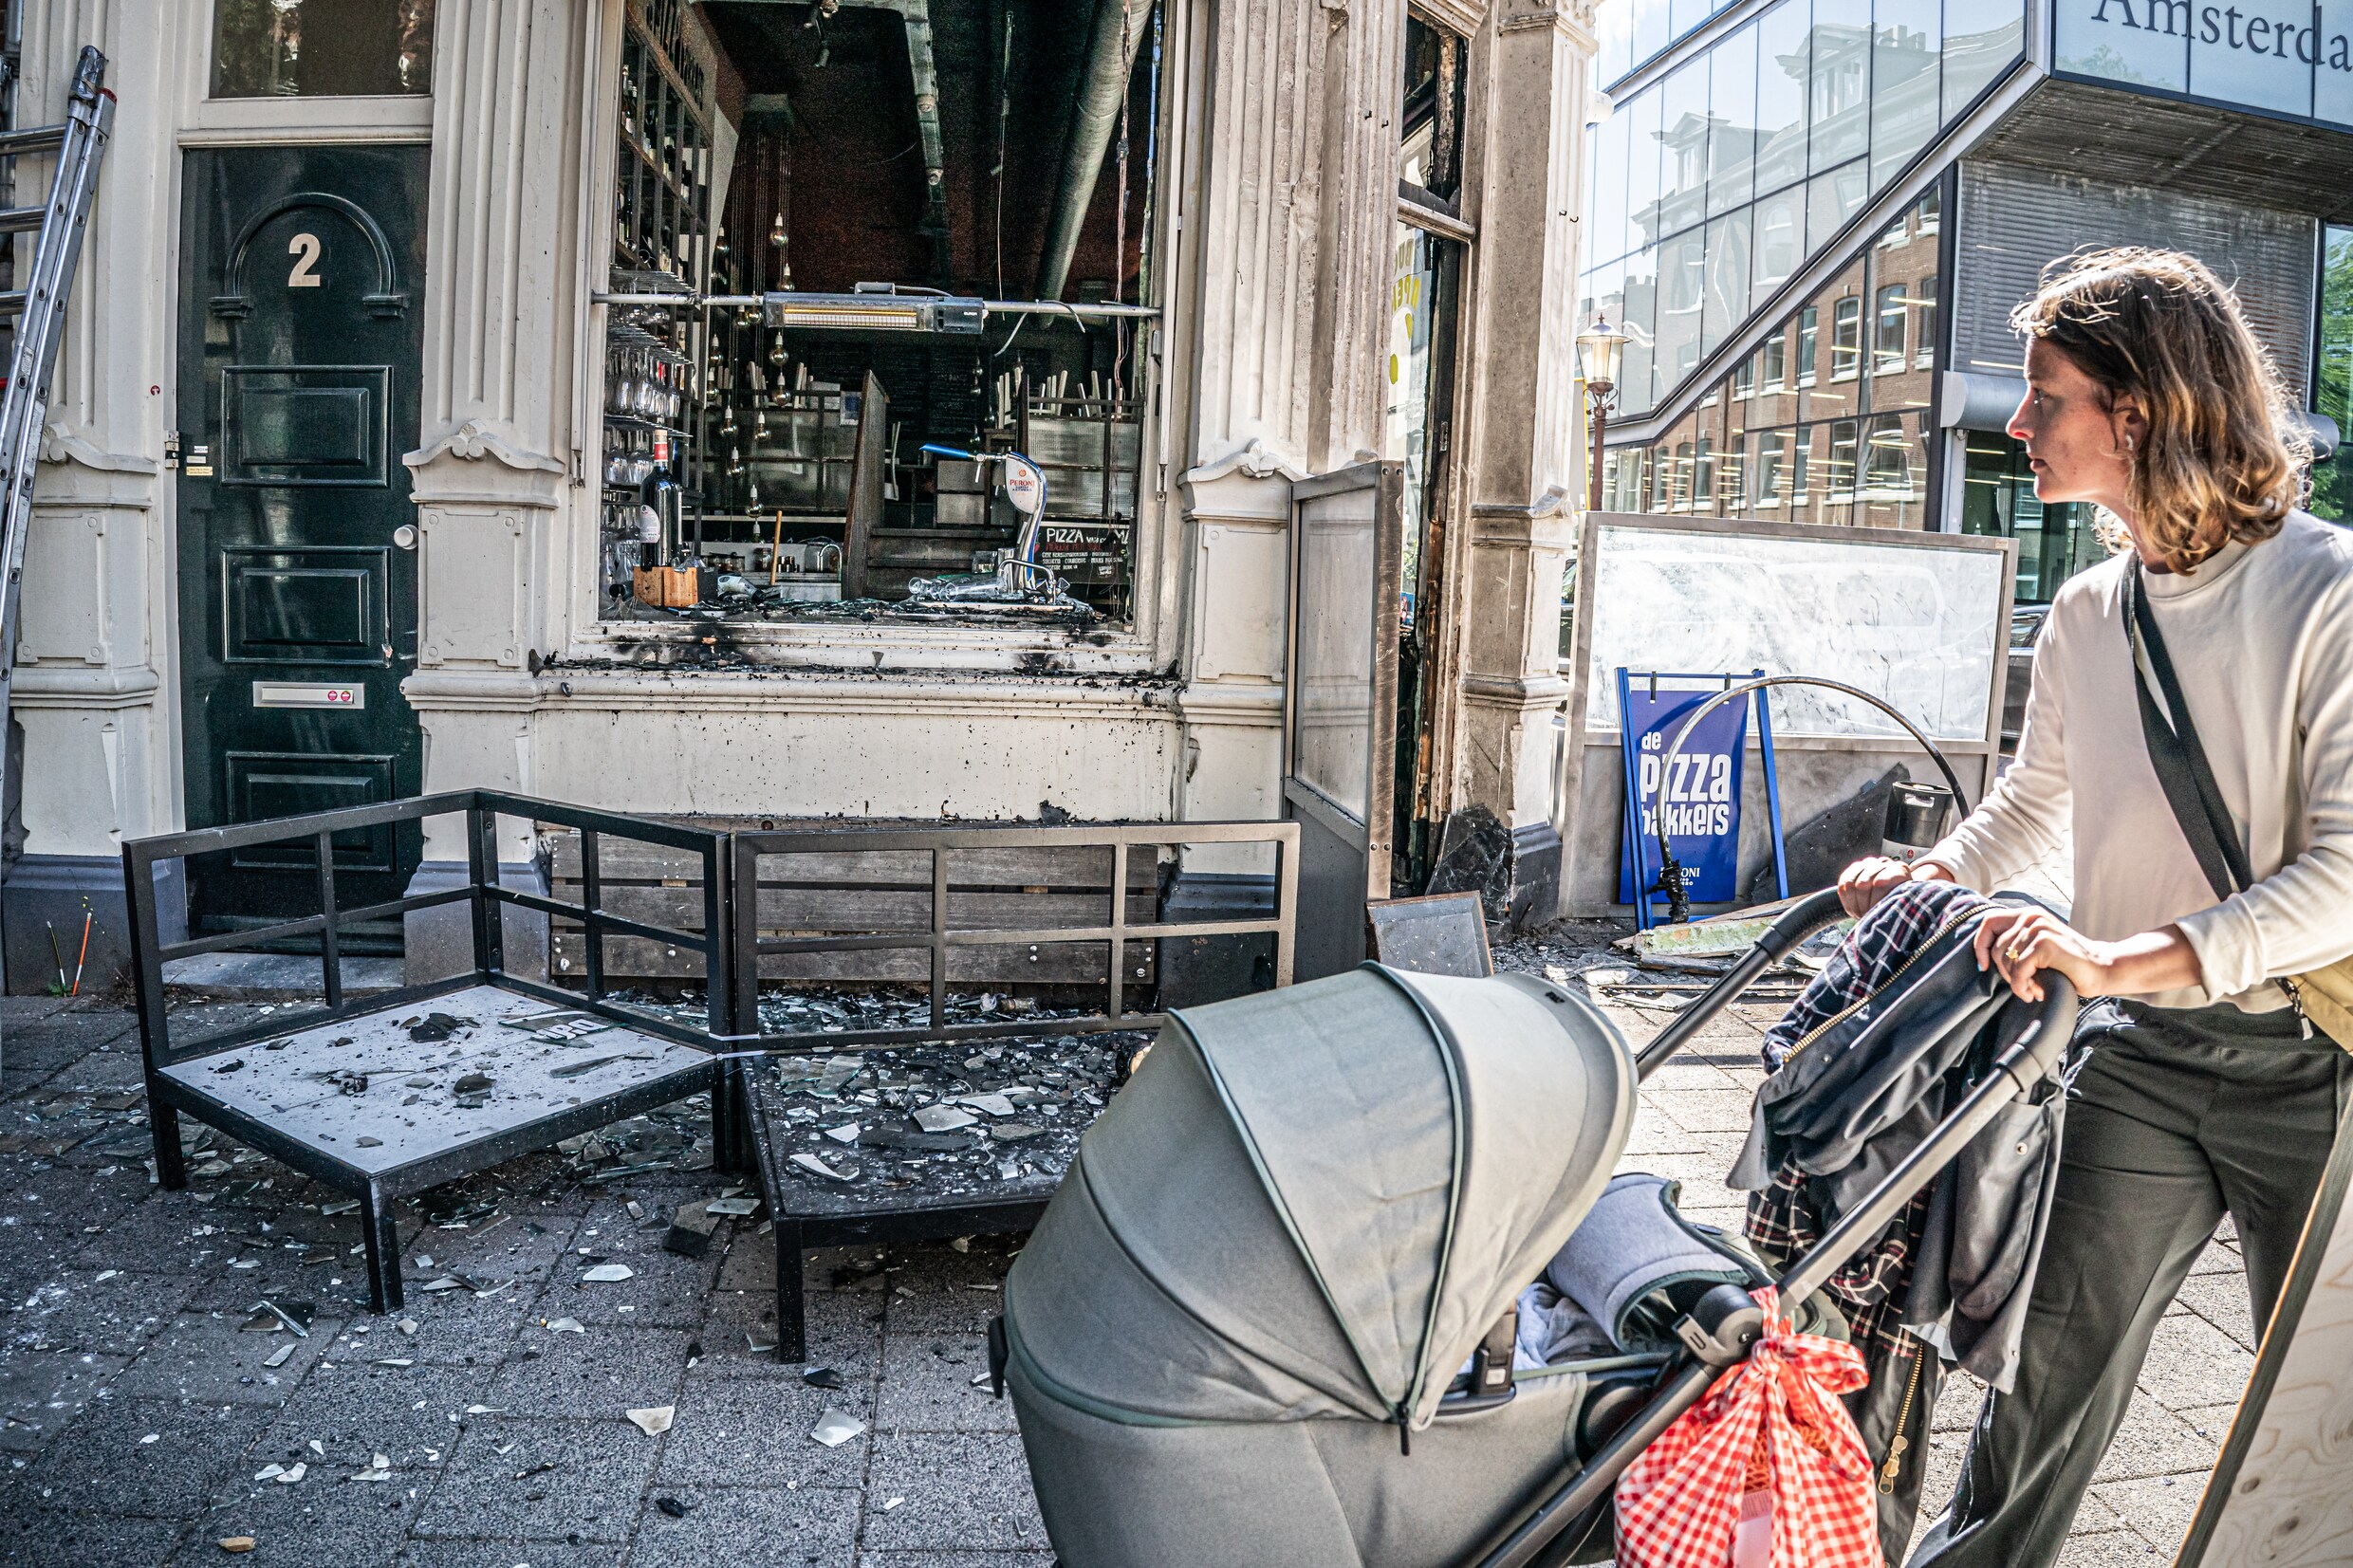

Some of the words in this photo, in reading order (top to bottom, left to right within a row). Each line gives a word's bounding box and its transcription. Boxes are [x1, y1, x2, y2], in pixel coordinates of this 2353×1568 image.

[288, 232, 321, 287] 2
[1047, 528, 1084, 543] PIZZA
[1641, 731, 1661, 750] de
[1660, 867, 1700, 877] ONI
